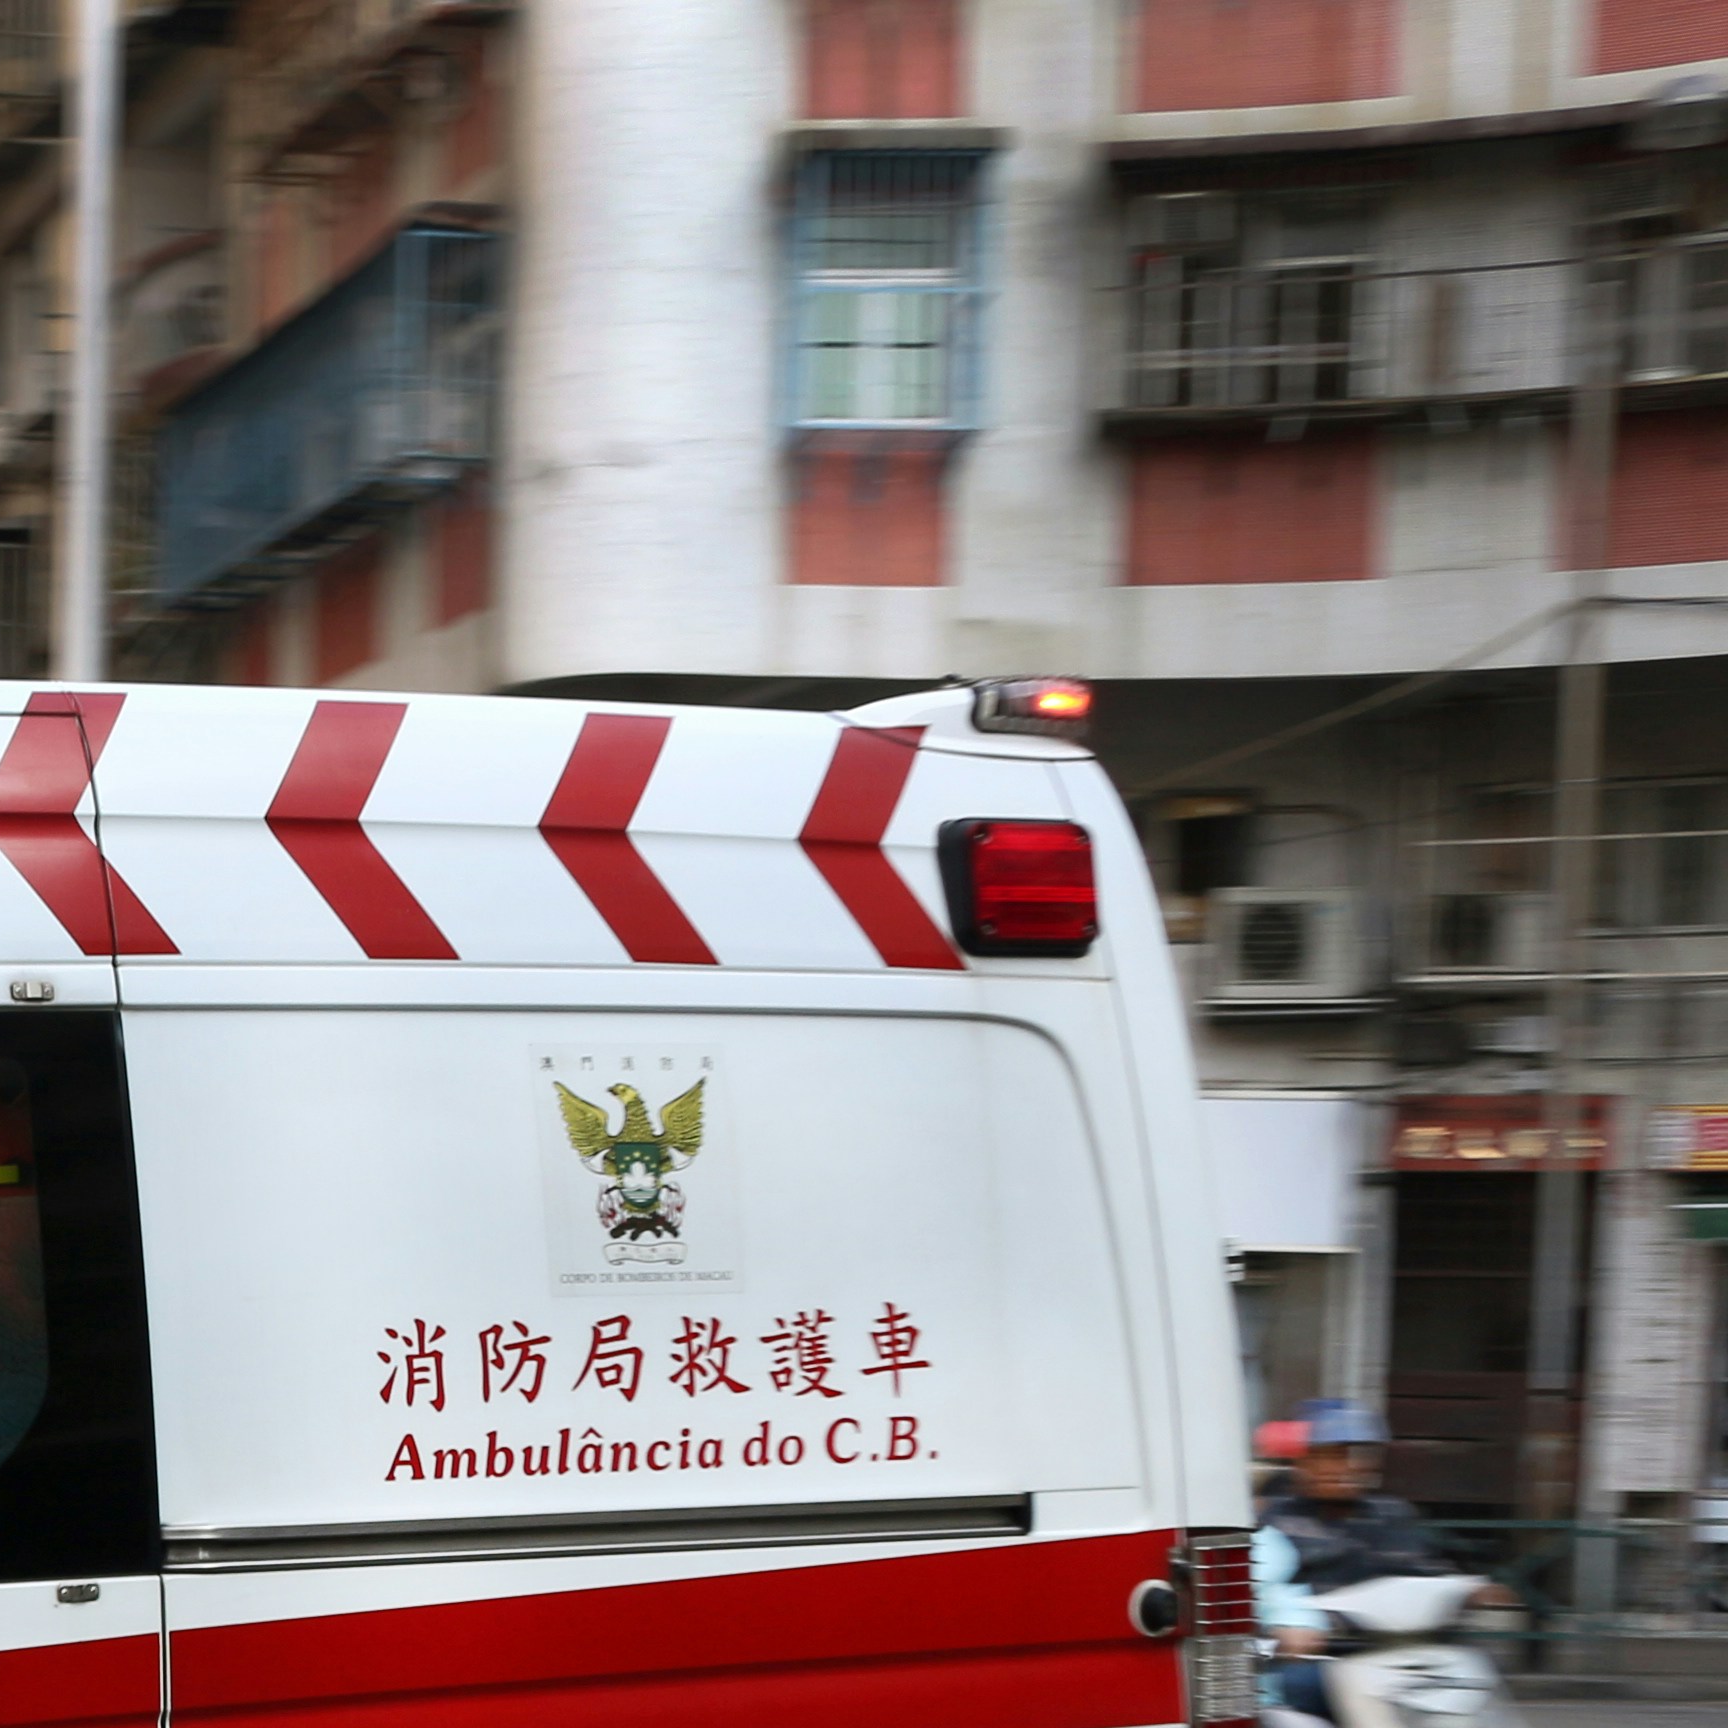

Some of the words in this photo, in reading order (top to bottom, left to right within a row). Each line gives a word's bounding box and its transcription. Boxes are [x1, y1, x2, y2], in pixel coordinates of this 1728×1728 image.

[378, 1303, 931, 1412] 消防局救護車
[386, 1428, 724, 1482] Ambulância
[742, 1421, 805, 1467] do
[825, 1415, 938, 1466] C.B.
